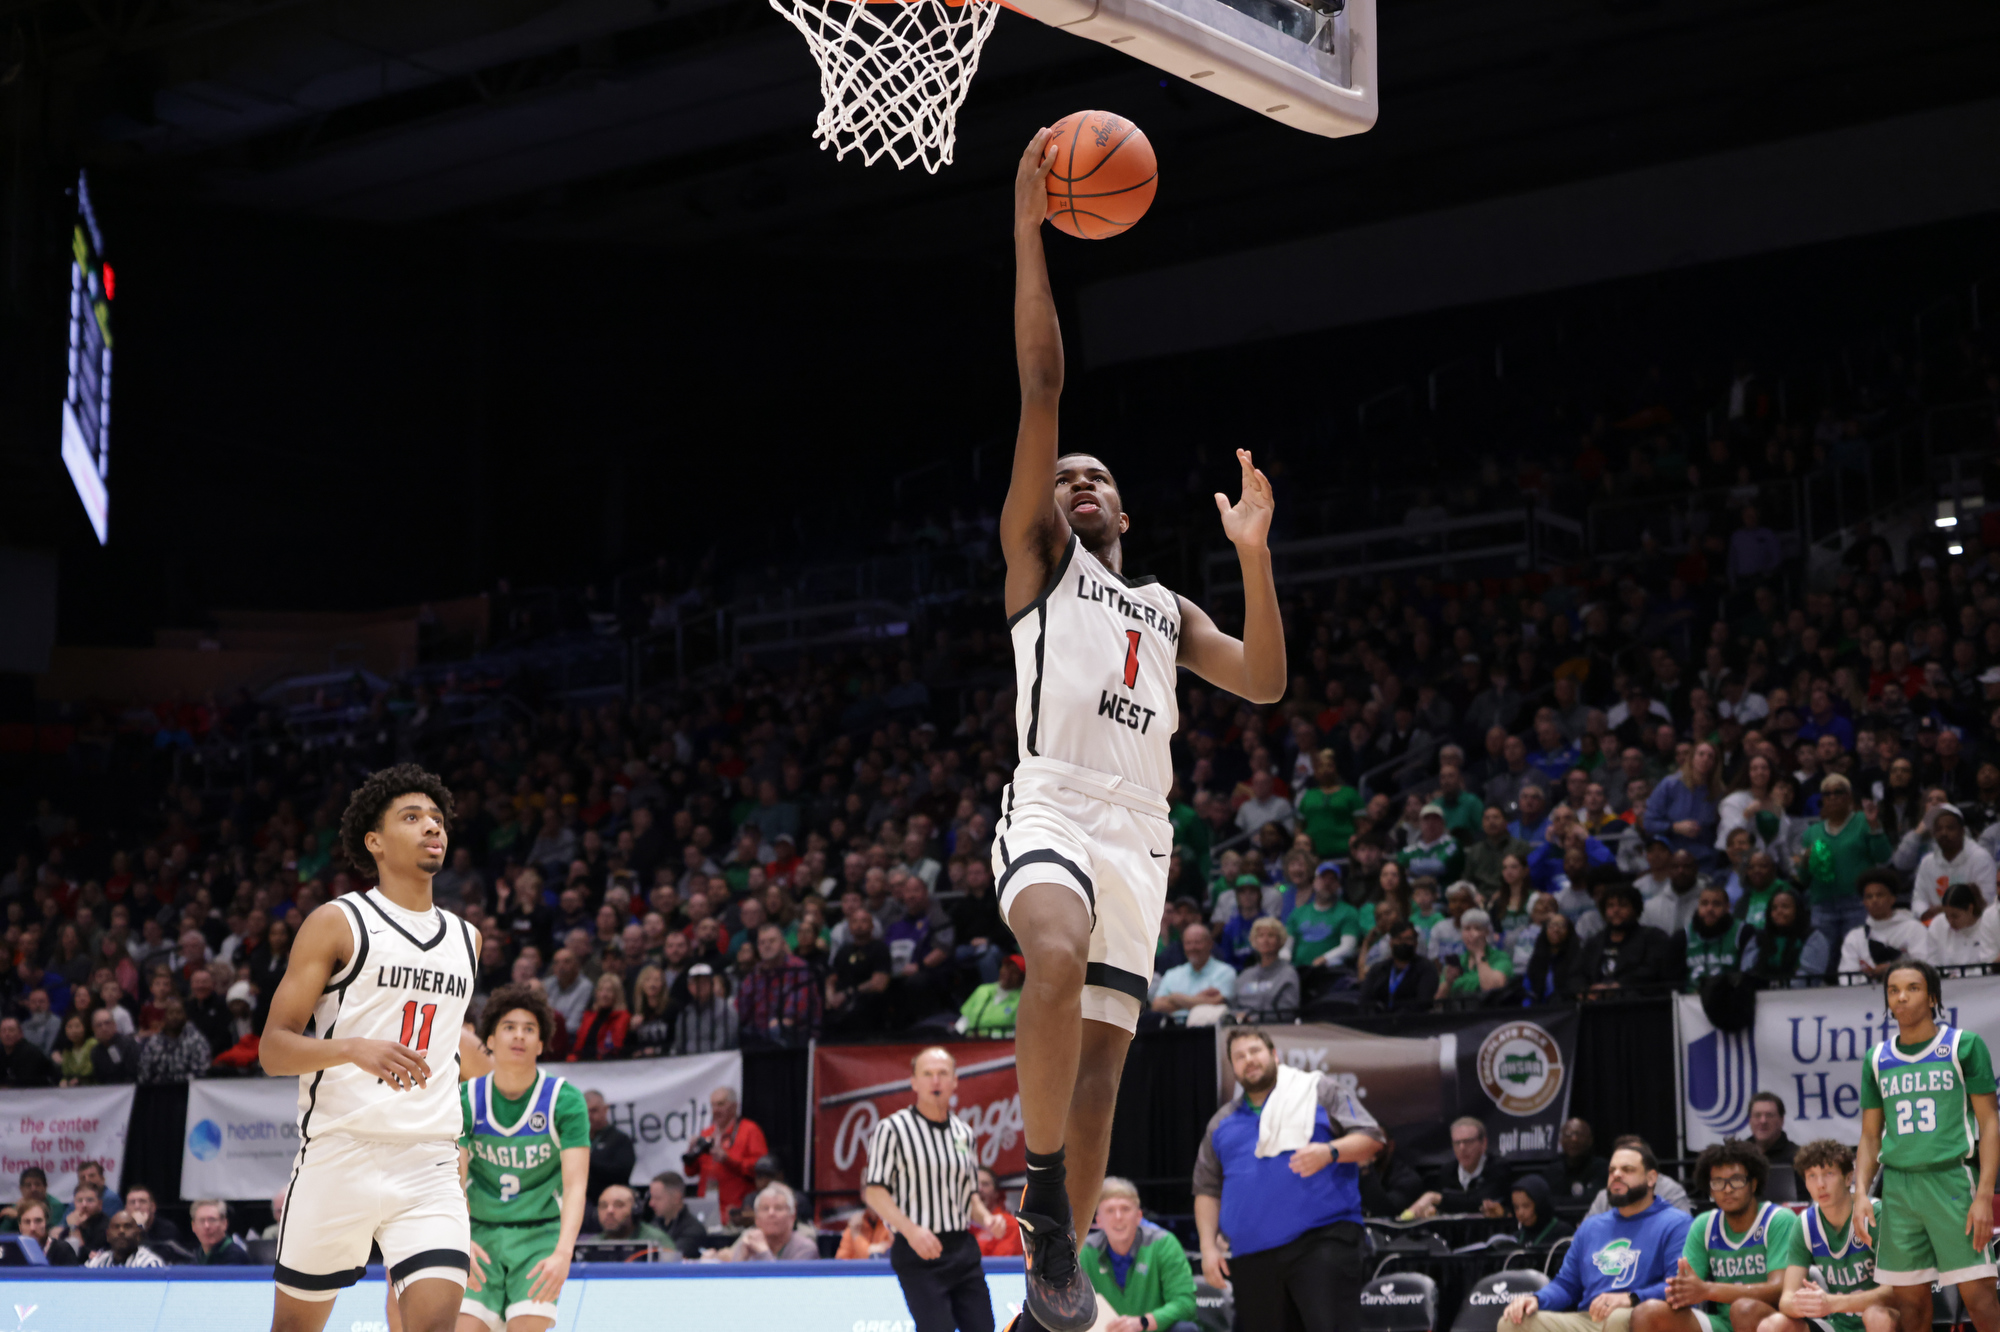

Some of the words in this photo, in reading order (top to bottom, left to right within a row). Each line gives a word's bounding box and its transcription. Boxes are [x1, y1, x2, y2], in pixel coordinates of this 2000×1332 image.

[1077, 574, 1179, 647] LUTHERAN
[1123, 629, 1142, 690] 1
[1098, 689, 1156, 735] WEST
[377, 965, 467, 999] LUTHERAN
[399, 1000, 438, 1059] 11
[1880, 1069, 1954, 1099] EAGLES
[20, 1117, 45, 1134] the
[49, 1116, 99, 1134] center
[227, 1121, 278, 1140] health
[609, 1098, 708, 1144] Healt
[1895, 1097, 1937, 1135] 23
[31, 1136, 53, 1153] for
[58, 1136, 85, 1153] the
[474, 1140, 552, 1169] EAGLES
[1499, 1128, 1518, 1157] got
[1520, 1124, 1554, 1151] milk?
[2, 1156, 55, 1174] female
[499, 1173, 521, 1203] 2
[1709, 1253, 1767, 1277] EAGLES
[1360, 1291, 1425, 1306] CareSource
